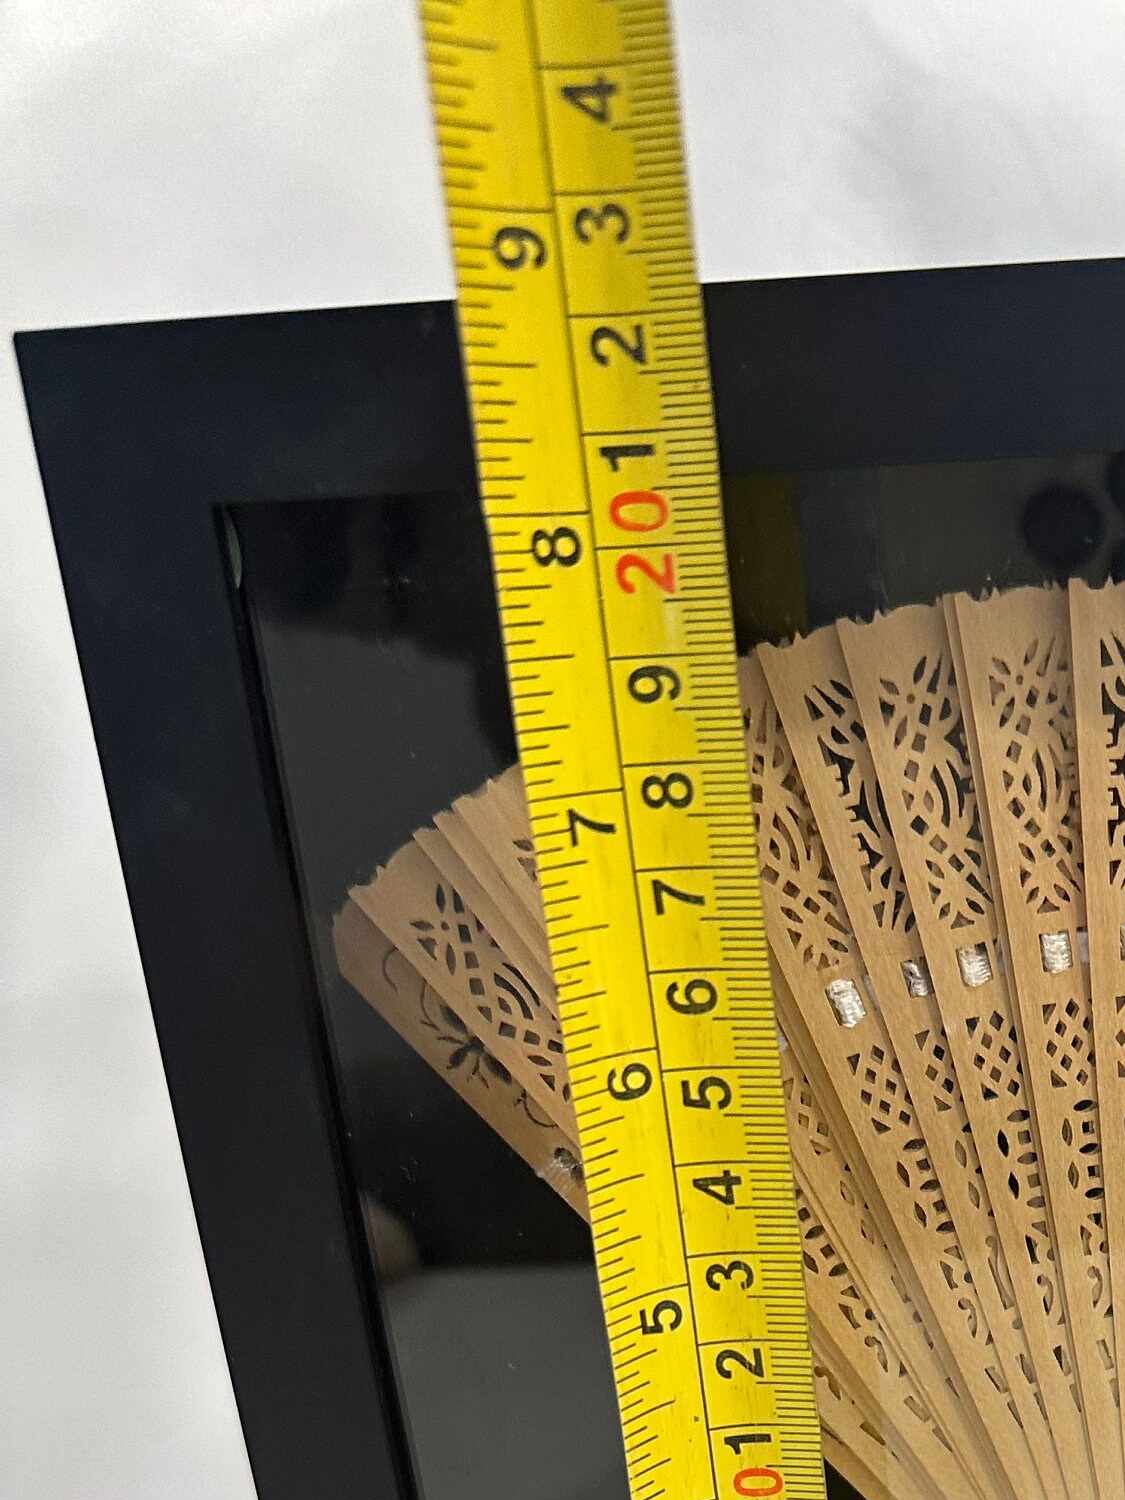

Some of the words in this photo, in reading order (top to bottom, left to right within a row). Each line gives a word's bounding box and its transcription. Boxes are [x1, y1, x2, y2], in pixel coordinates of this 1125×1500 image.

[560, 76, 618, 123] 4
[574, 203, 629, 245] 3
[492, 227, 547, 269] 9
[590, 324, 646, 366] 2
[599, 444, 655, 472] 1
[532, 527, 580, 567] 8
[609, 490, 675, 594] 20
[628, 665, 680, 704] 9
[641, 772, 694, 809] 8
[568, 808, 616, 847] 7
[652, 879, 705, 916] 7
[667, 979, 717, 1015] 6
[607, 1062, 652, 1101] 6
[680, 1076, 732, 1110] 5
[692, 1170, 742, 1205] 4
[705, 1260, 754, 1291] 3
[639, 1300, 682, 1335] 5
[716, 1348, 764, 1379] 2
[724, 1434, 772, 1455] 1
